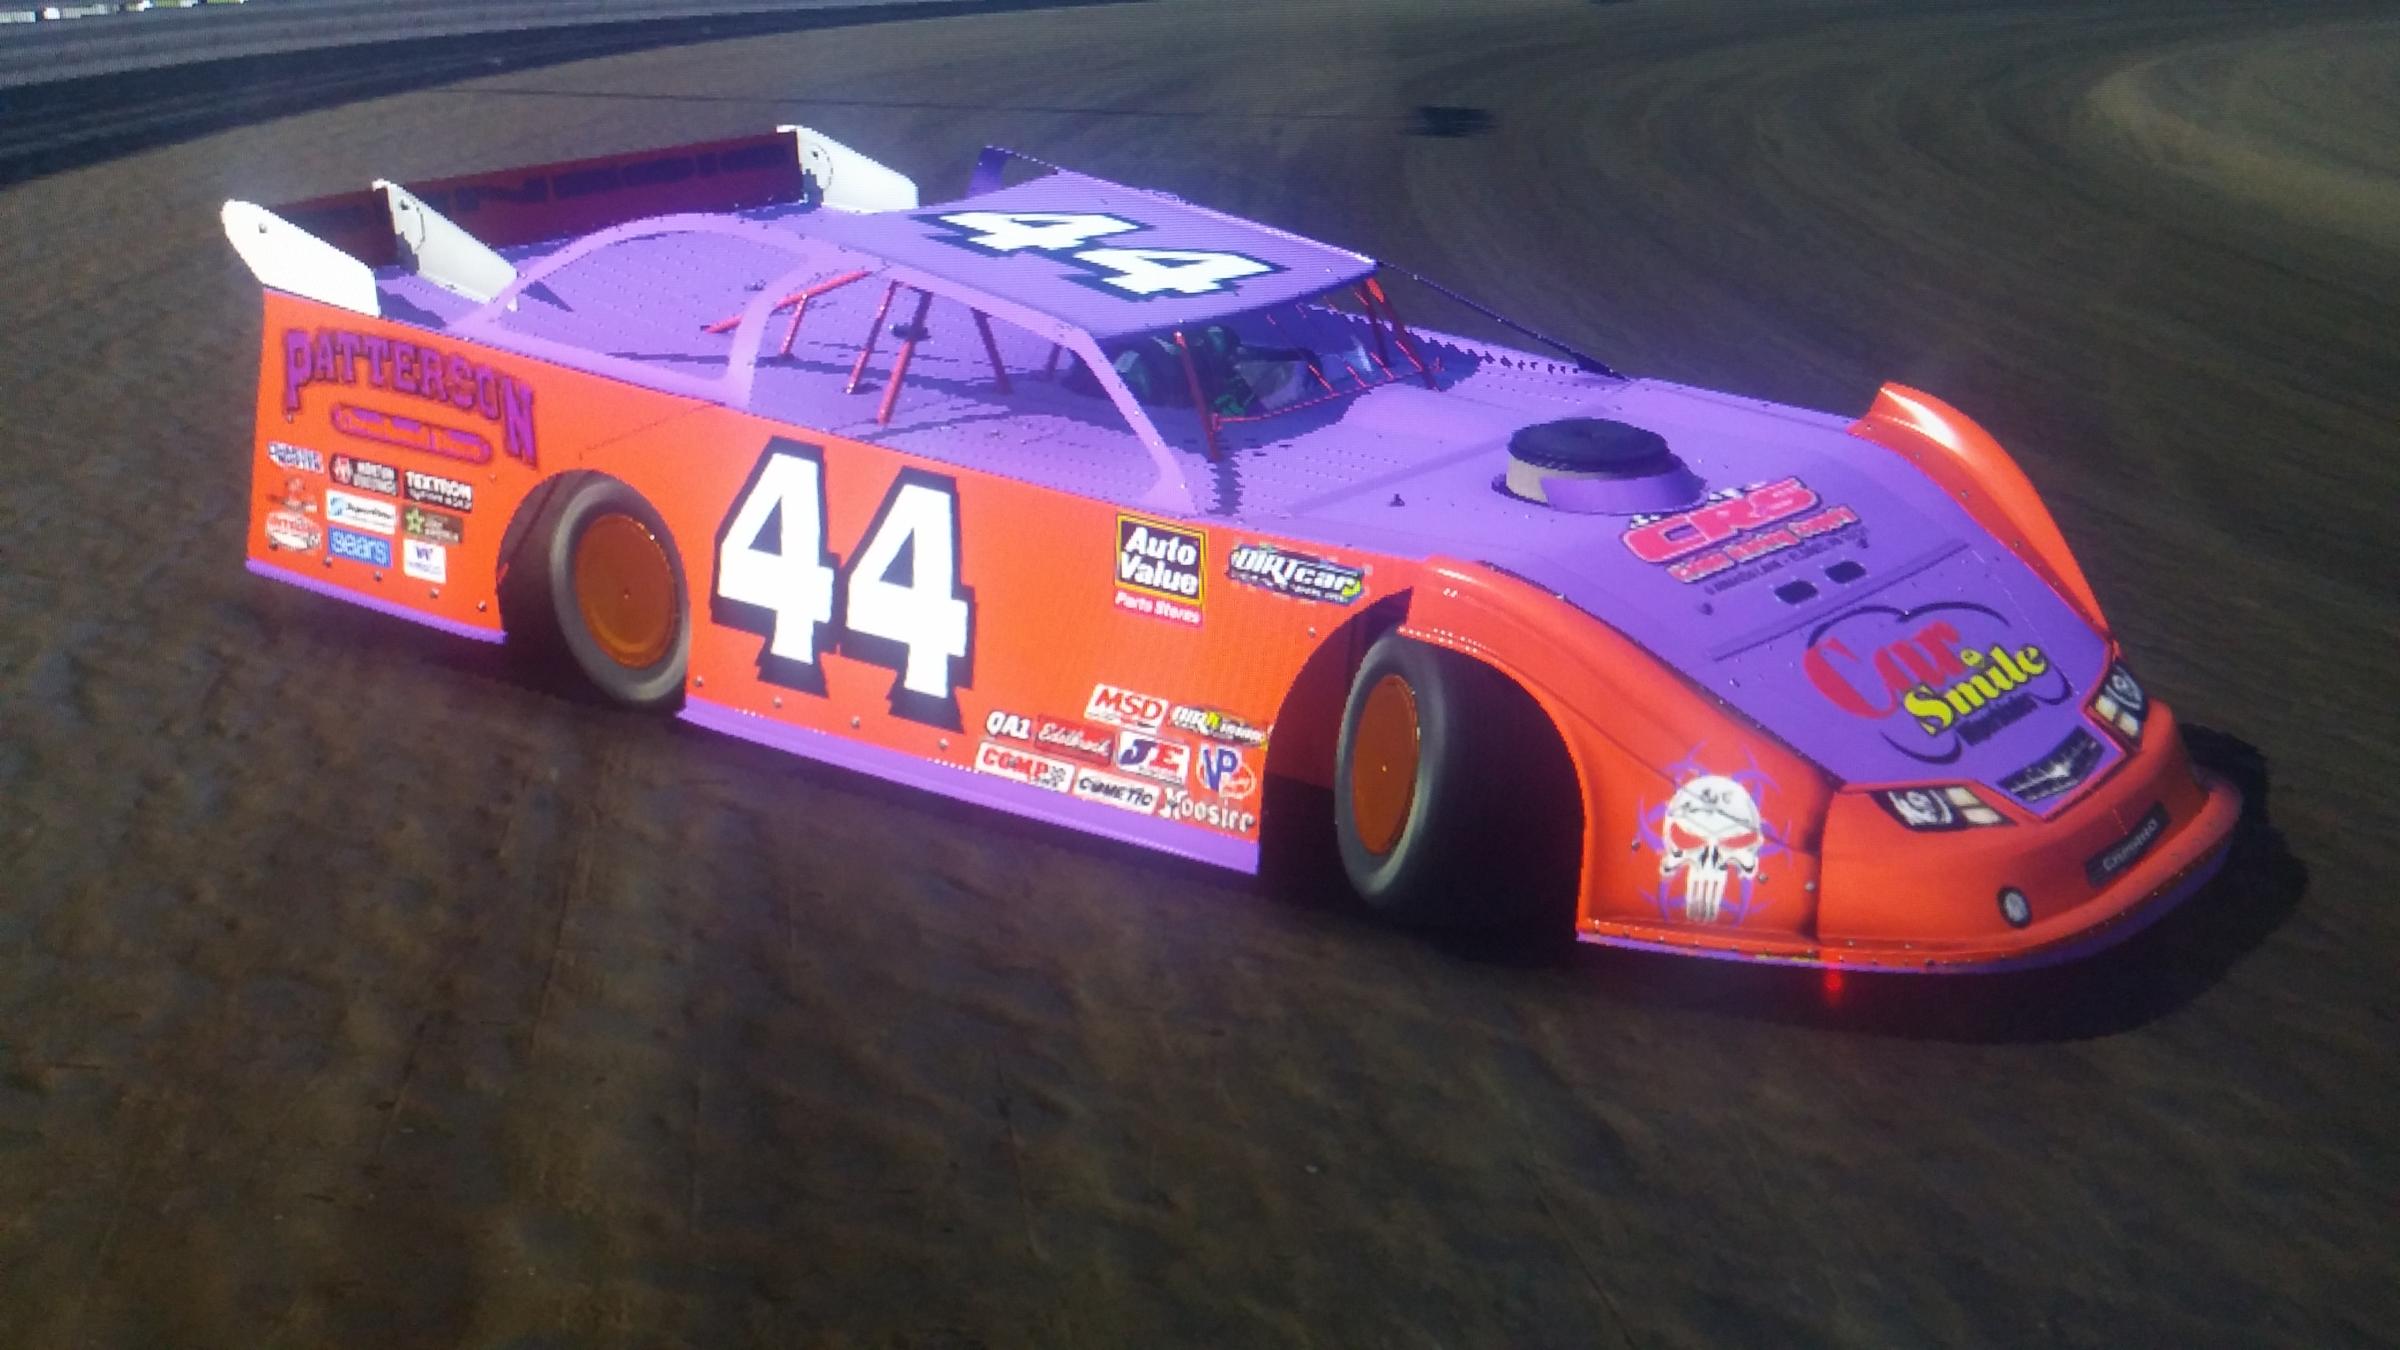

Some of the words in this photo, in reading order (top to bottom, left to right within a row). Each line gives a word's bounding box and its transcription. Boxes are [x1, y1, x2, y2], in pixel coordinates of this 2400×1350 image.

[910, 211, 1290, 301] 44
[284, 327, 537, 469] PATTERSON
[1620, 476, 1822, 563] CRS
[331, 528, 390, 567] sears
[1125, 526, 1198, 566] Auto
[709, 435, 977, 734] 44
[1119, 550, 1199, 596] Value
[1114, 589, 1152, 614] Parts
[1153, 598, 1200, 624] Stores
[1803, 620, 1967, 720] Car
[1903, 642, 2048, 736] Smile
[986, 711, 1031, 740] QA1
[1094, 688, 1163, 720] MSD
[982, 746, 1049, 779] COMP
[1119, 738, 1184, 771] JE
[1203, 748, 1239, 792] VP
